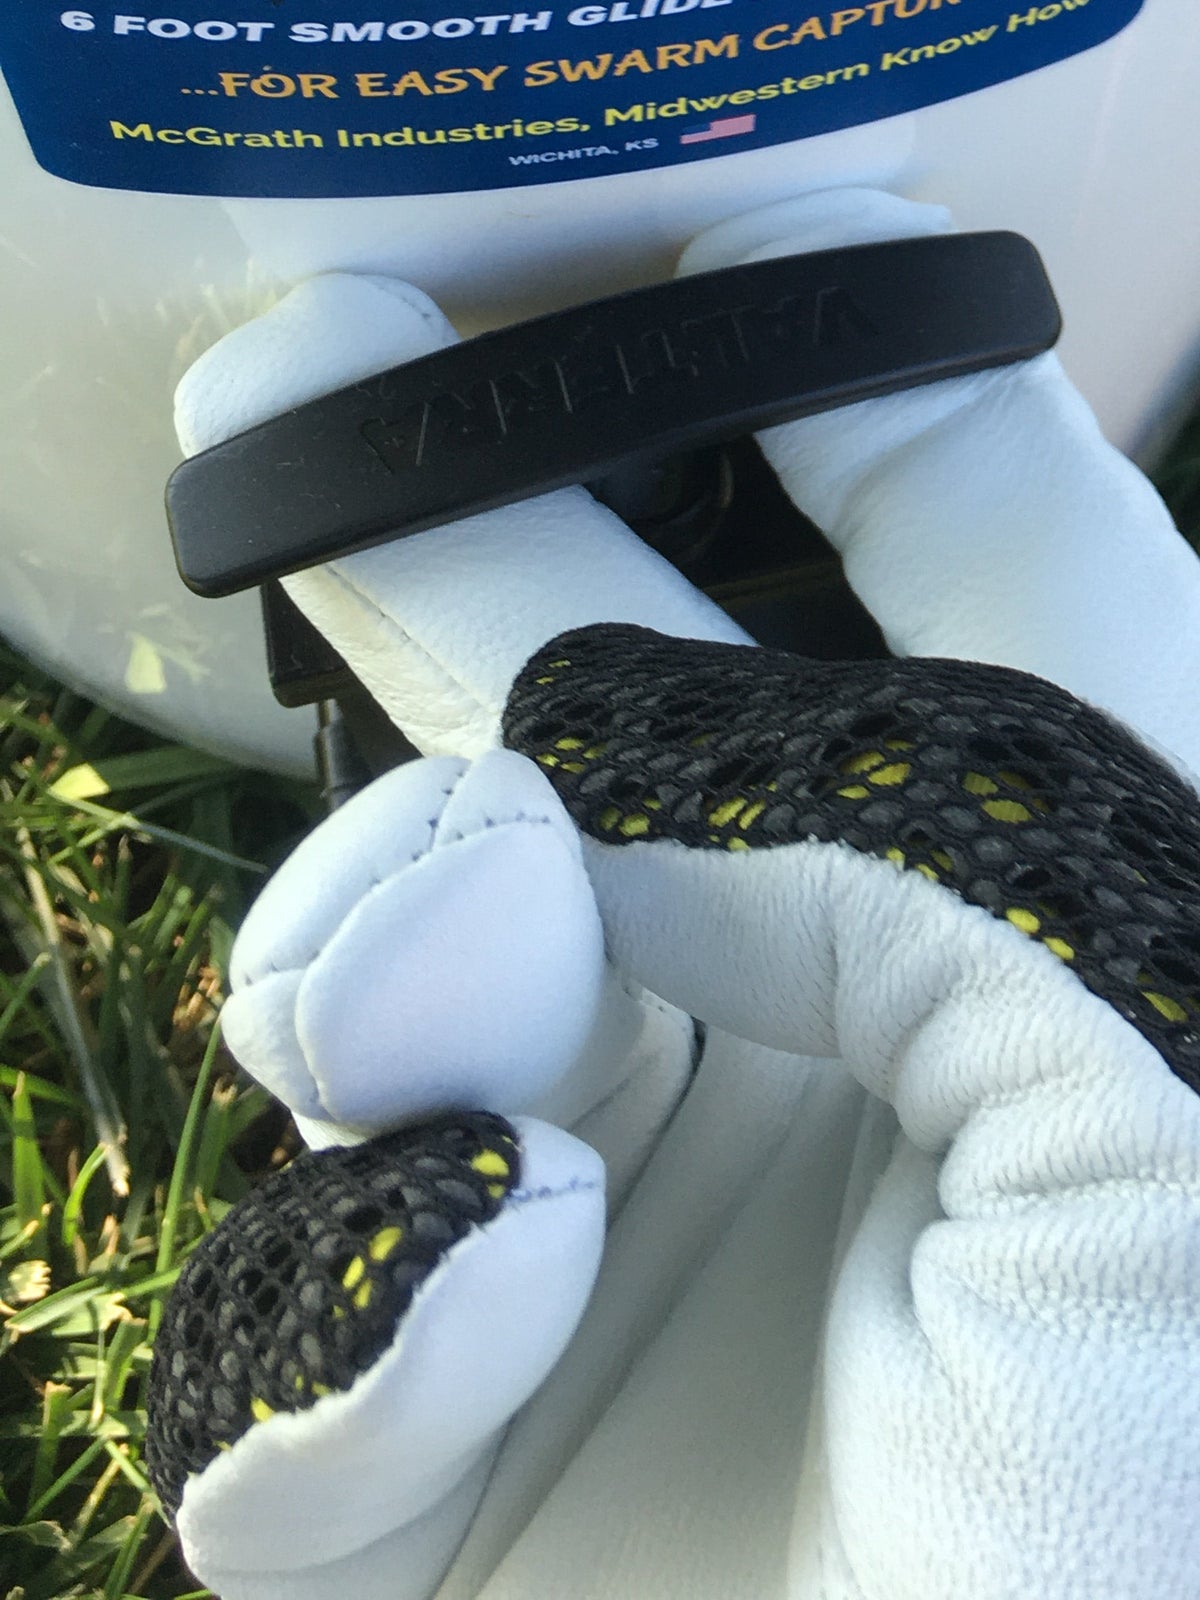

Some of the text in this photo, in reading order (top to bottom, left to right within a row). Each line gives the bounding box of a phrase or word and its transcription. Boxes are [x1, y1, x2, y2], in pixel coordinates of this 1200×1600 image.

[60, 10, 95, 31] 6
[113, 14, 275, 42] FOOT
[288, 10, 552, 43] SMOOTH
[109, 120, 324, 148] McGrath
[337, 117, 590, 148] Industries,
[604, 63, 870, 126] Midwestern
[880, 25, 998, 71] Know
[354, 65, 508, 97] EASY
[524, 33, 739, 87] SWARM
[508, 138, 659, 166] WICHITA, KS
